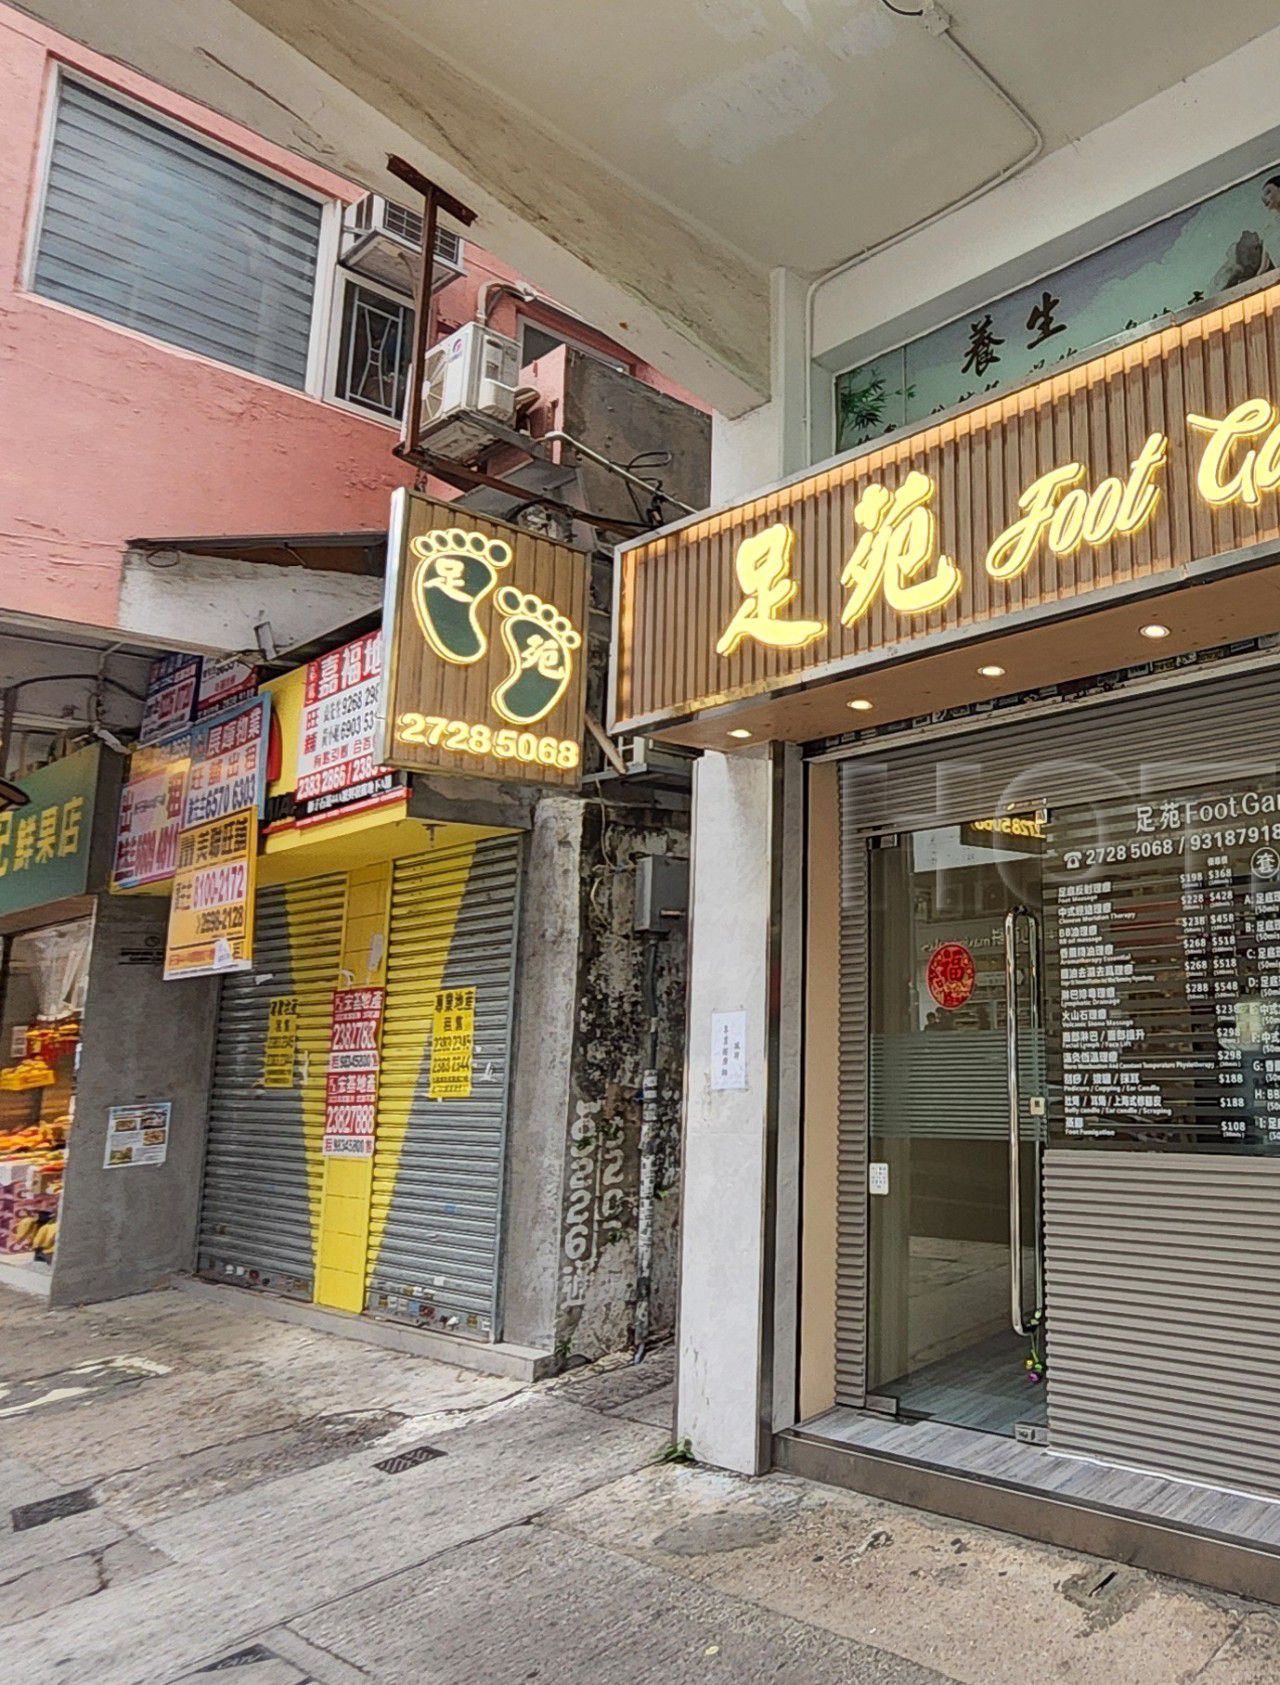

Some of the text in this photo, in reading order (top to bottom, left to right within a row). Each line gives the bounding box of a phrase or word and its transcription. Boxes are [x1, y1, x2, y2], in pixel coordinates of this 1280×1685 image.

[961, 291, 1068, 377] 養生
[715, 471, 960, 656] 足苑
[986, 432, 1167, 579] Foot
[424, 558, 474, 603] 足
[521, 634, 567, 680] 苑
[1135, 803, 1181, 834] 足苑
[1185, 798, 1238, 825] Foot
[1086, 843, 1126, 865] 2728
[1130, 838, 1173, 859] 5068
[1208, 869, 1232, 880] $368
[1210, 890, 1233, 901] $428
[1210, 913, 1234, 924] $458
[1183, 936, 1236, 949] $268 $518
[1184, 958, 1237, 971] $268 $518
[1214, 981, 1238, 992] $548
[1218, 1050, 1241, 1060] $298
[1218, 1074, 1243, 1084] $188
[1220, 1097, 1245, 1108] $188
[1221, 1121, 1246, 1132] $108
